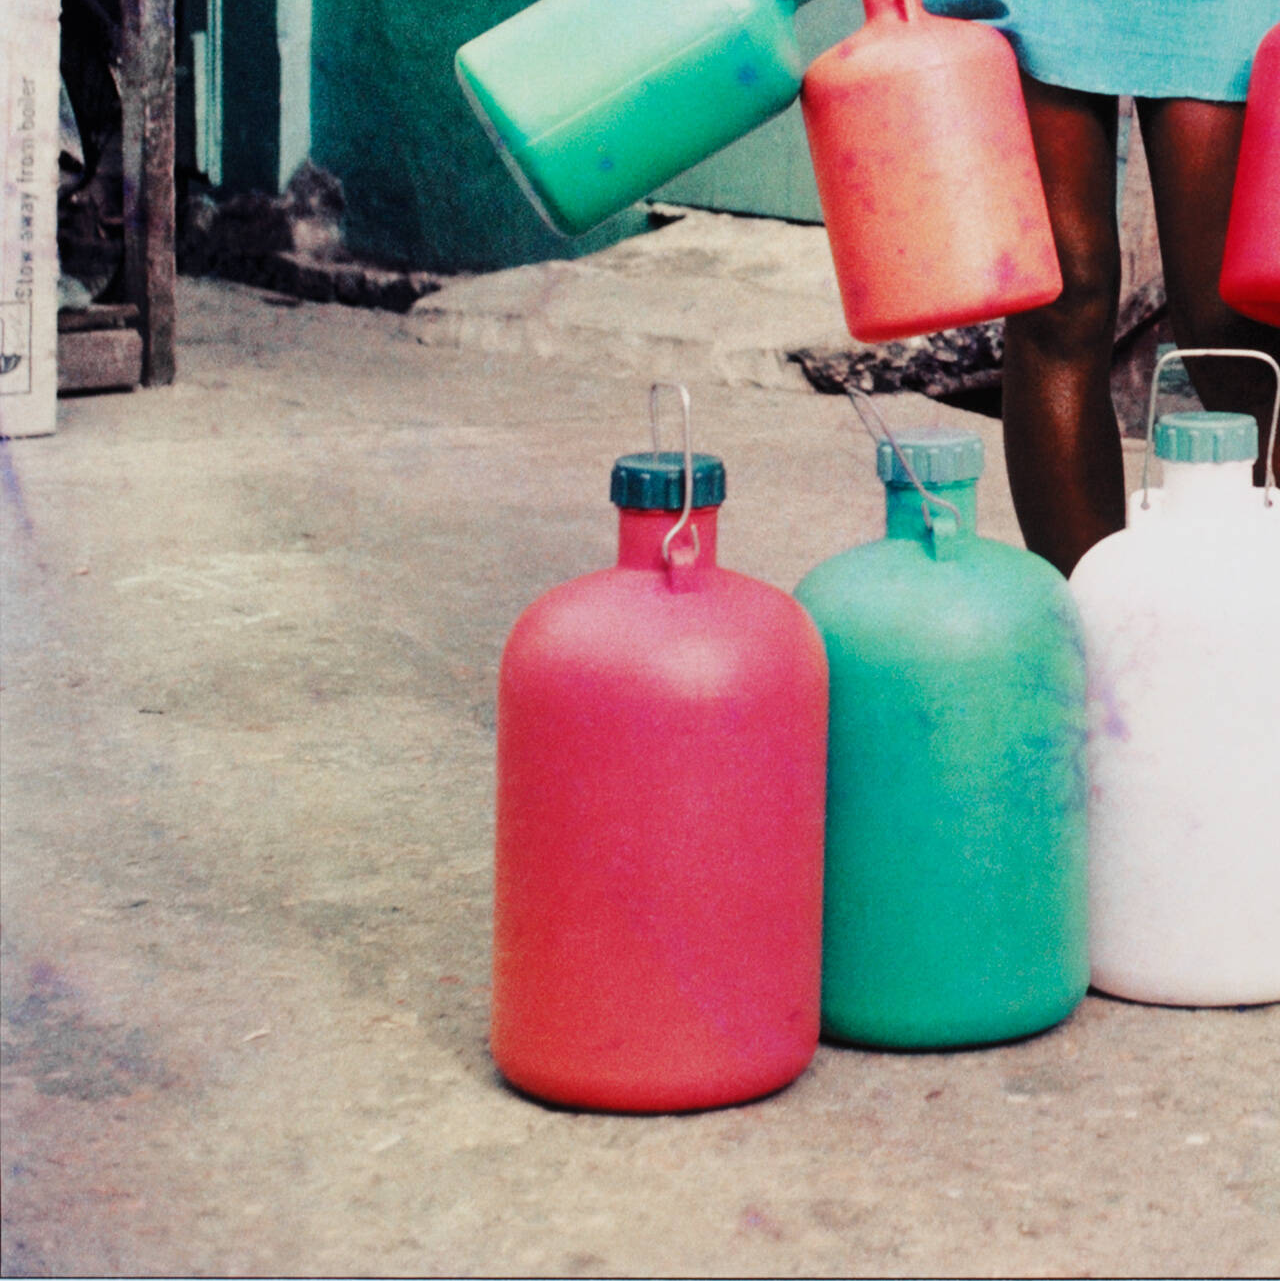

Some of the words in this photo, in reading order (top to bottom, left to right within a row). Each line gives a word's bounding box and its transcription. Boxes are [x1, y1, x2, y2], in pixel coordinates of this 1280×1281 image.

[17, 76, 36, 131] boiler
[16, 138, 34, 183] from
[20, 193, 38, 241] away
[15, 250, 33, 300] Stow
